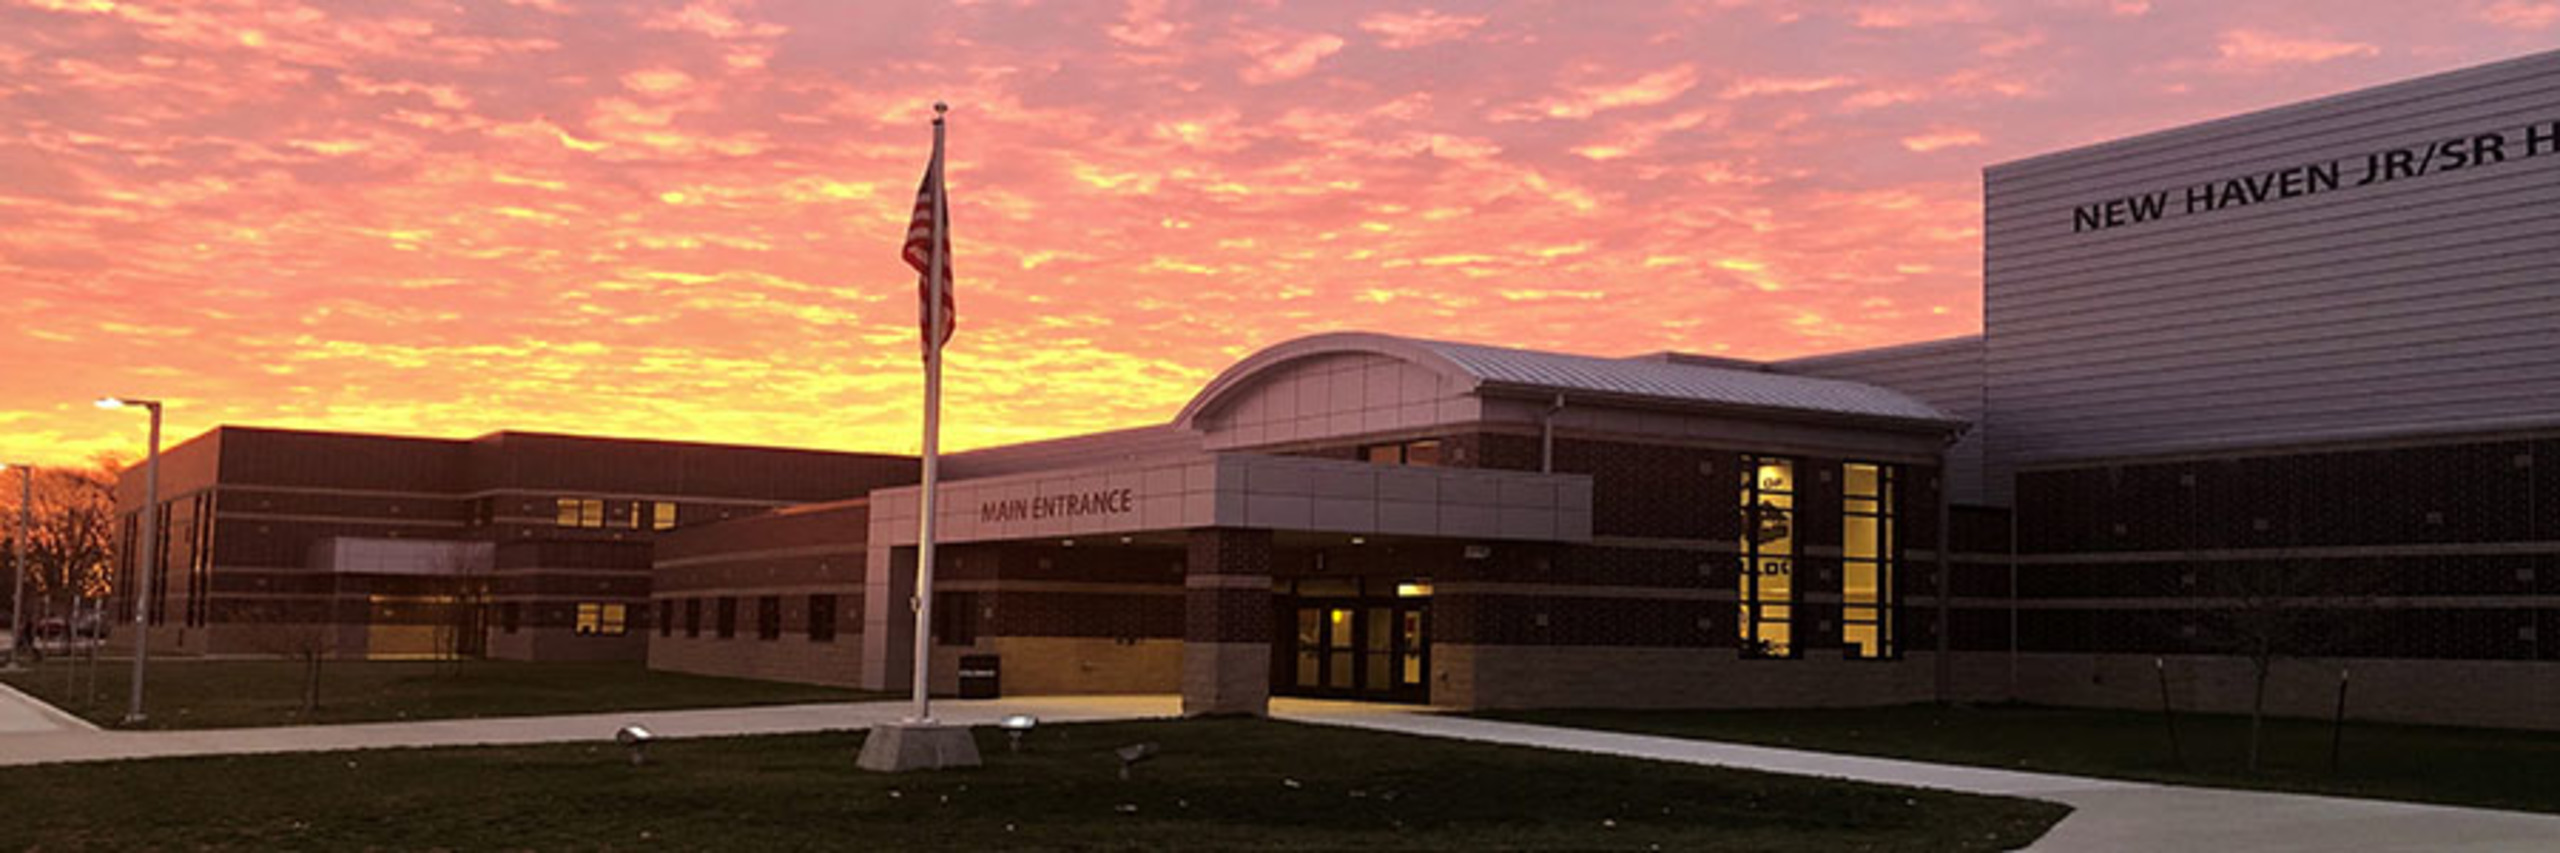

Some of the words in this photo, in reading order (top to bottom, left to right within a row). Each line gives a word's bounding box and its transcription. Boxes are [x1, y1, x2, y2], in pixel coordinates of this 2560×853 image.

[2073, 191, 2169, 233] NEW
[2186, 161, 2340, 215] HAVEN
[2357, 133, 2506, 186] JR/SR
[981, 499, 1027, 523] MAIN
[1032, 488, 1132, 519] ENTRANCE
